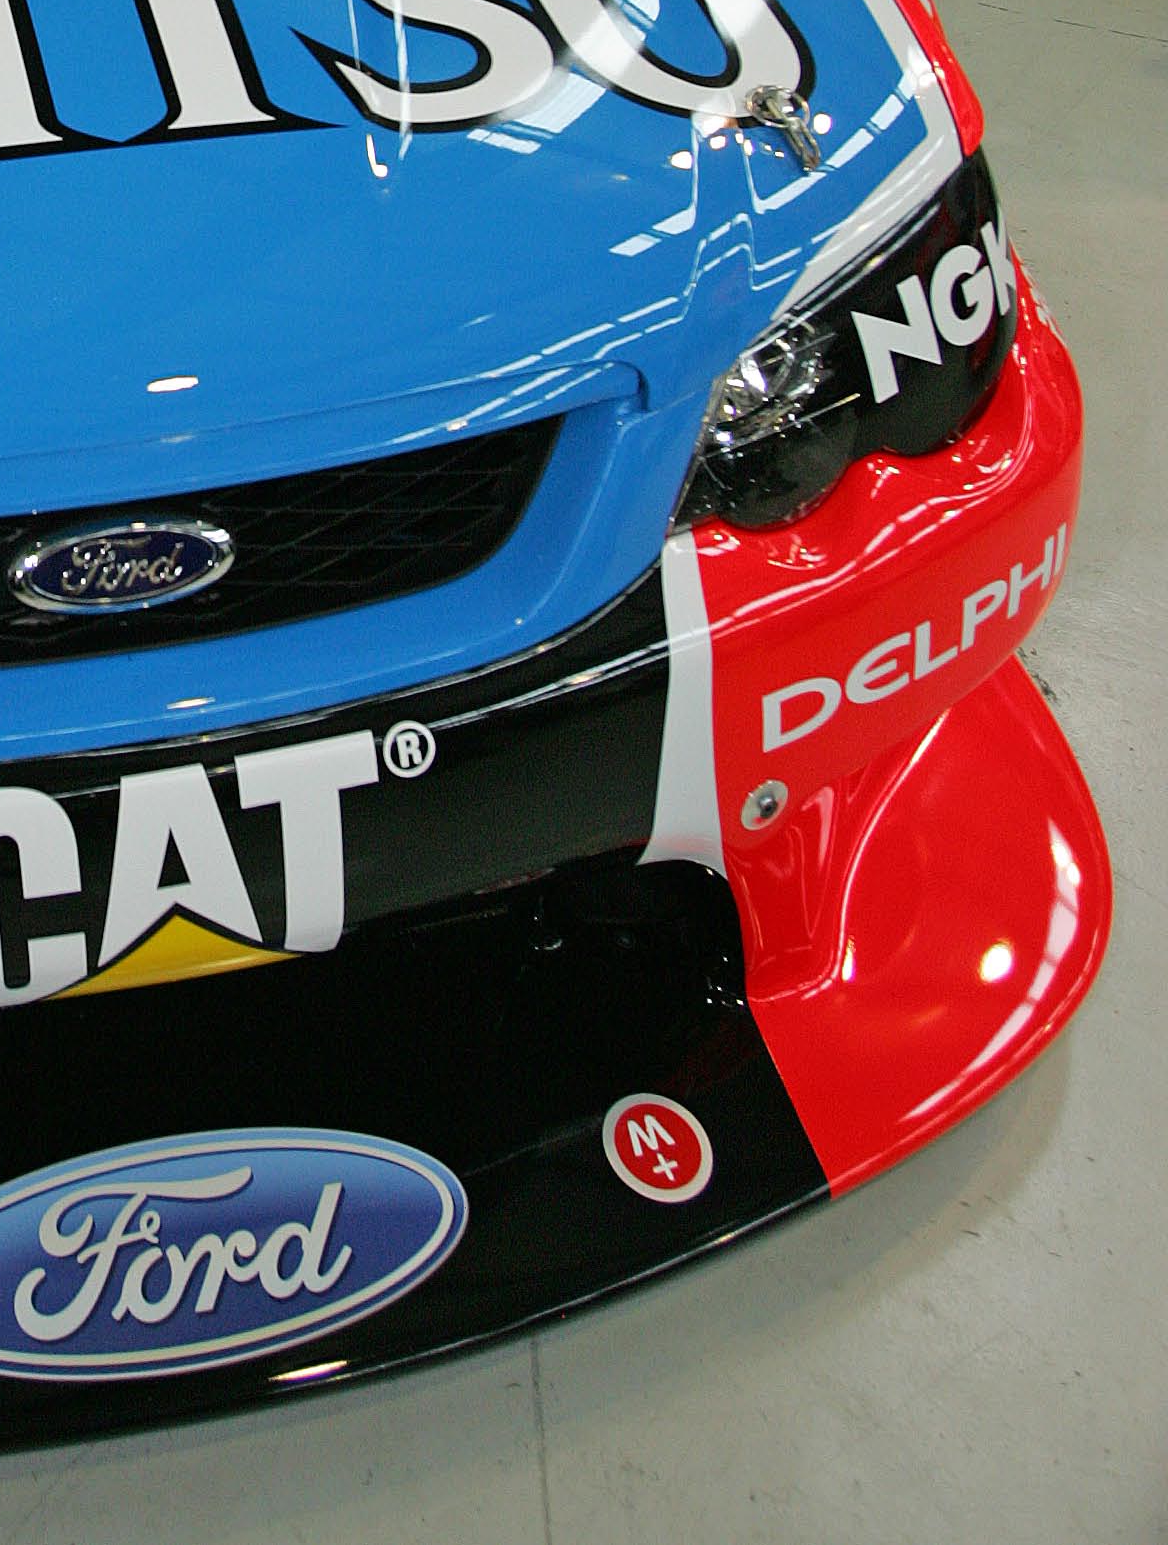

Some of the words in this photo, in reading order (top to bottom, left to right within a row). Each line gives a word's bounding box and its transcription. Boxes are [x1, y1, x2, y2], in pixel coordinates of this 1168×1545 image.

[62, 534, 183, 596] Ford
[761, 522, 1067, 754] DELPHI
[14, 1165, 351, 1344] Ford
